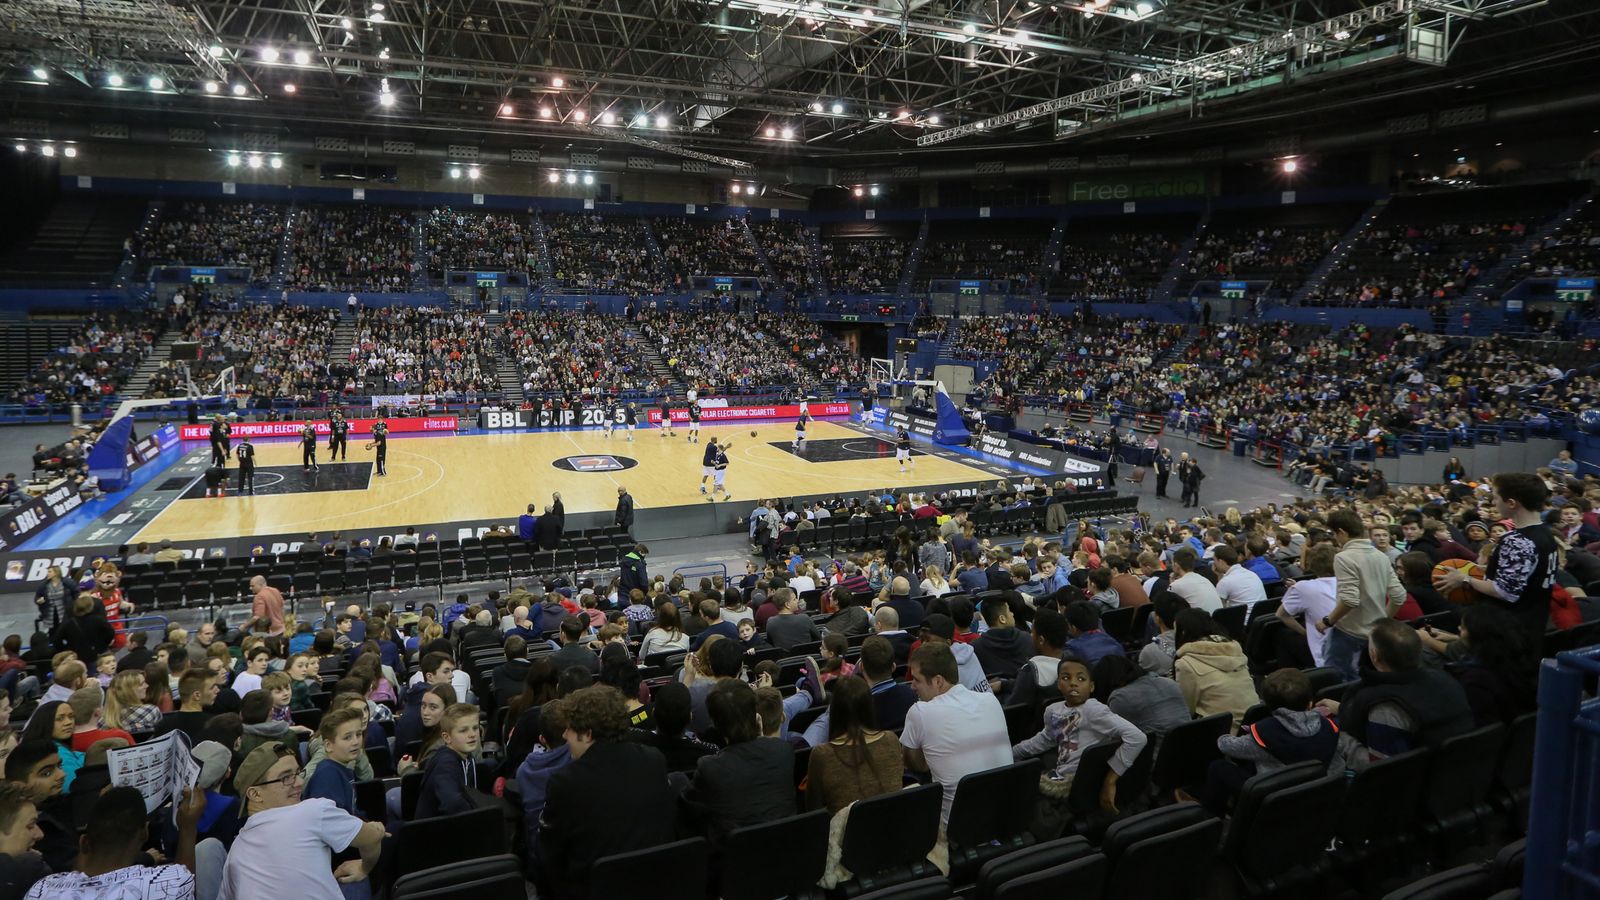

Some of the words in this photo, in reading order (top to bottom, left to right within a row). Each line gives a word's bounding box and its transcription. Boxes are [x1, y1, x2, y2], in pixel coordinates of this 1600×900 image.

[1072, 181, 1129, 201] Free
[1132, 177, 1200, 199] radio
[487, 411, 527, 428] BBL
[582, 408, 626, 426] 205
[717, 408, 749, 418] ELECTRONIC
[749, 407, 776, 416] CIGARETTE
[184, 427, 199, 437] THE
[240, 424, 273, 435] POPULAR
